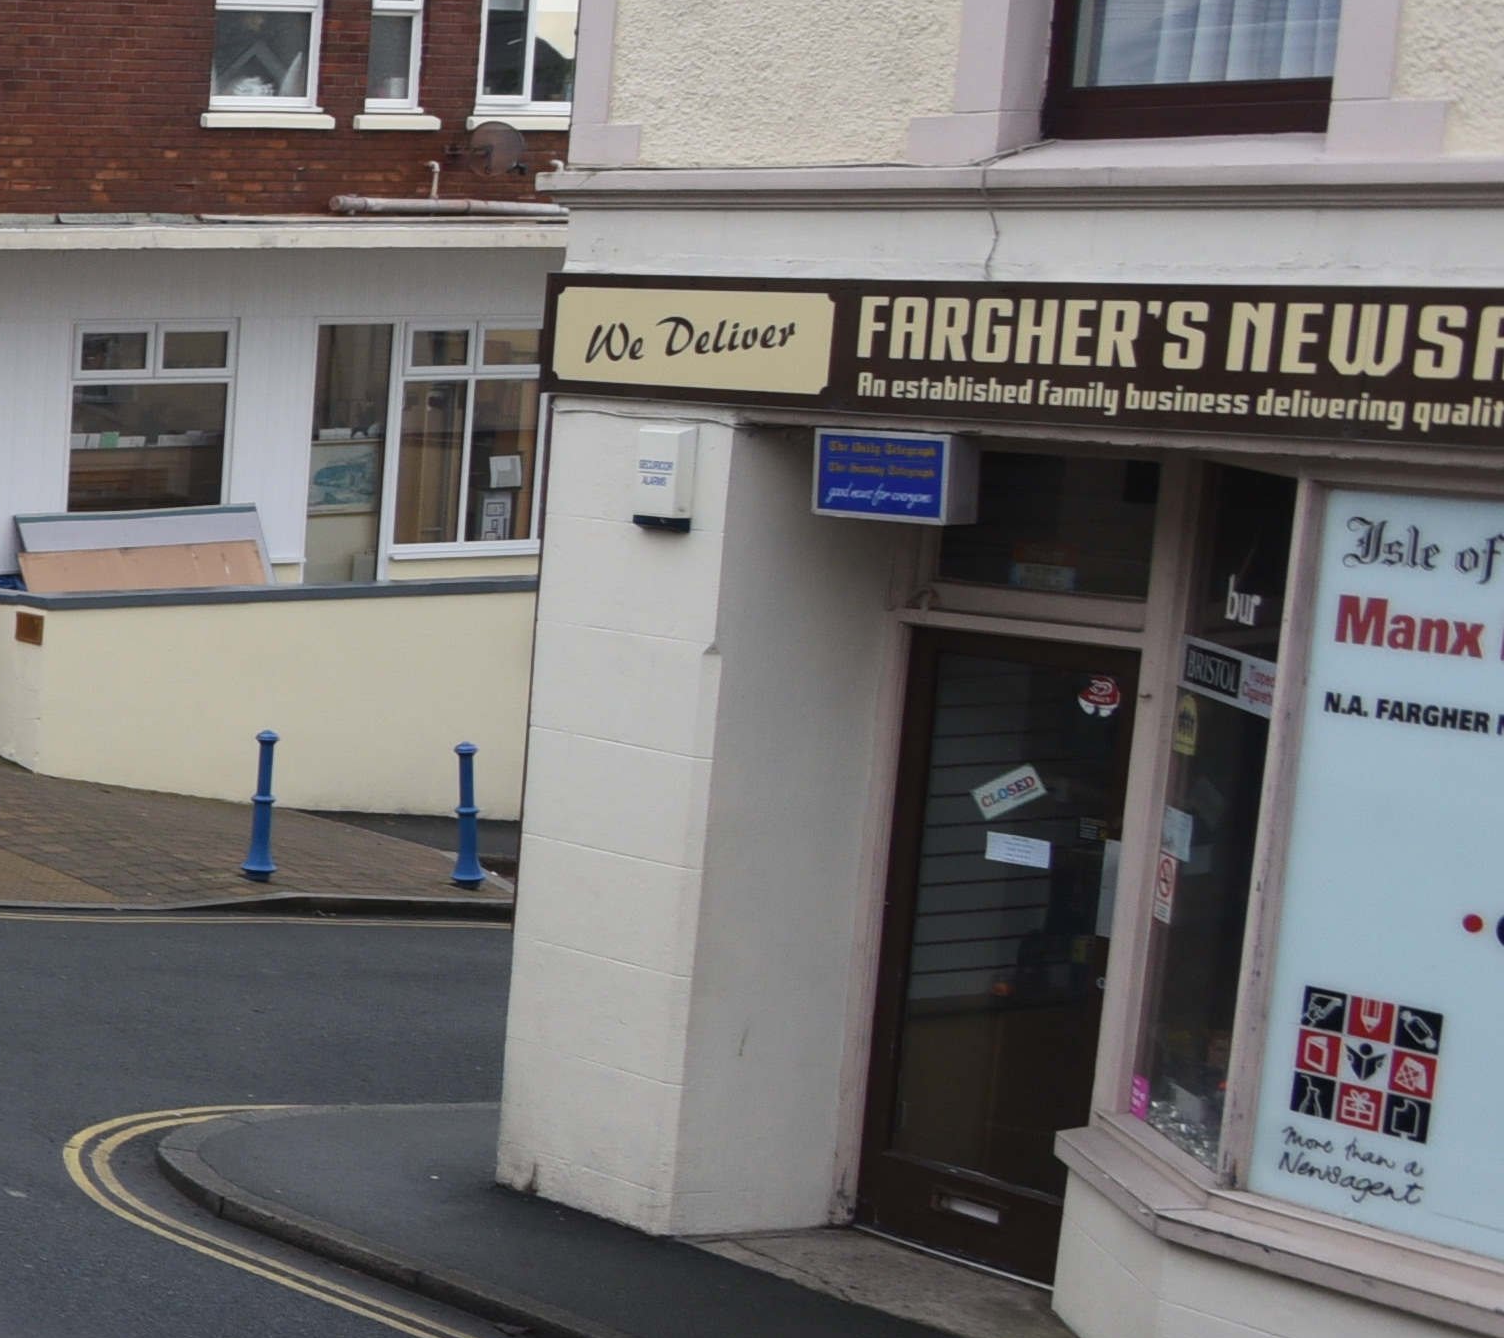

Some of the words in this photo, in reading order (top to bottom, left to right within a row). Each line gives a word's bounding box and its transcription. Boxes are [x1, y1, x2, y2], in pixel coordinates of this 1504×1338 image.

[585, 322, 644, 363] We
[656, 316, 796, 357] Deliver
[856, 296, 1210, 370] FARGHER'S
[857, 372, 886, 397] An
[891, 373, 1032, 406] established
[1038, 378, 1119, 416] family
[1125, 383, 1249, 416] business
[1256, 389, 1405, 430] delivering
[1342, 516, 1440, 571] Isle
[1454, 534, 1504, 585] of
[1224, 574, 1263, 626] bur
[1334, 595, 1485, 659] Manx
[1188, 650, 1237, 692] BRISTOL
[1323, 692, 1368, 717] N.A.
[1375, 698, 1490, 734] FARGHER
[981, 775, 1036, 808] CLOSED
[1278, 1152, 1425, 1204] Newsagent
[1345, 1137, 1396, 1169] than
[1404, 1161, 1424, 1177] a
